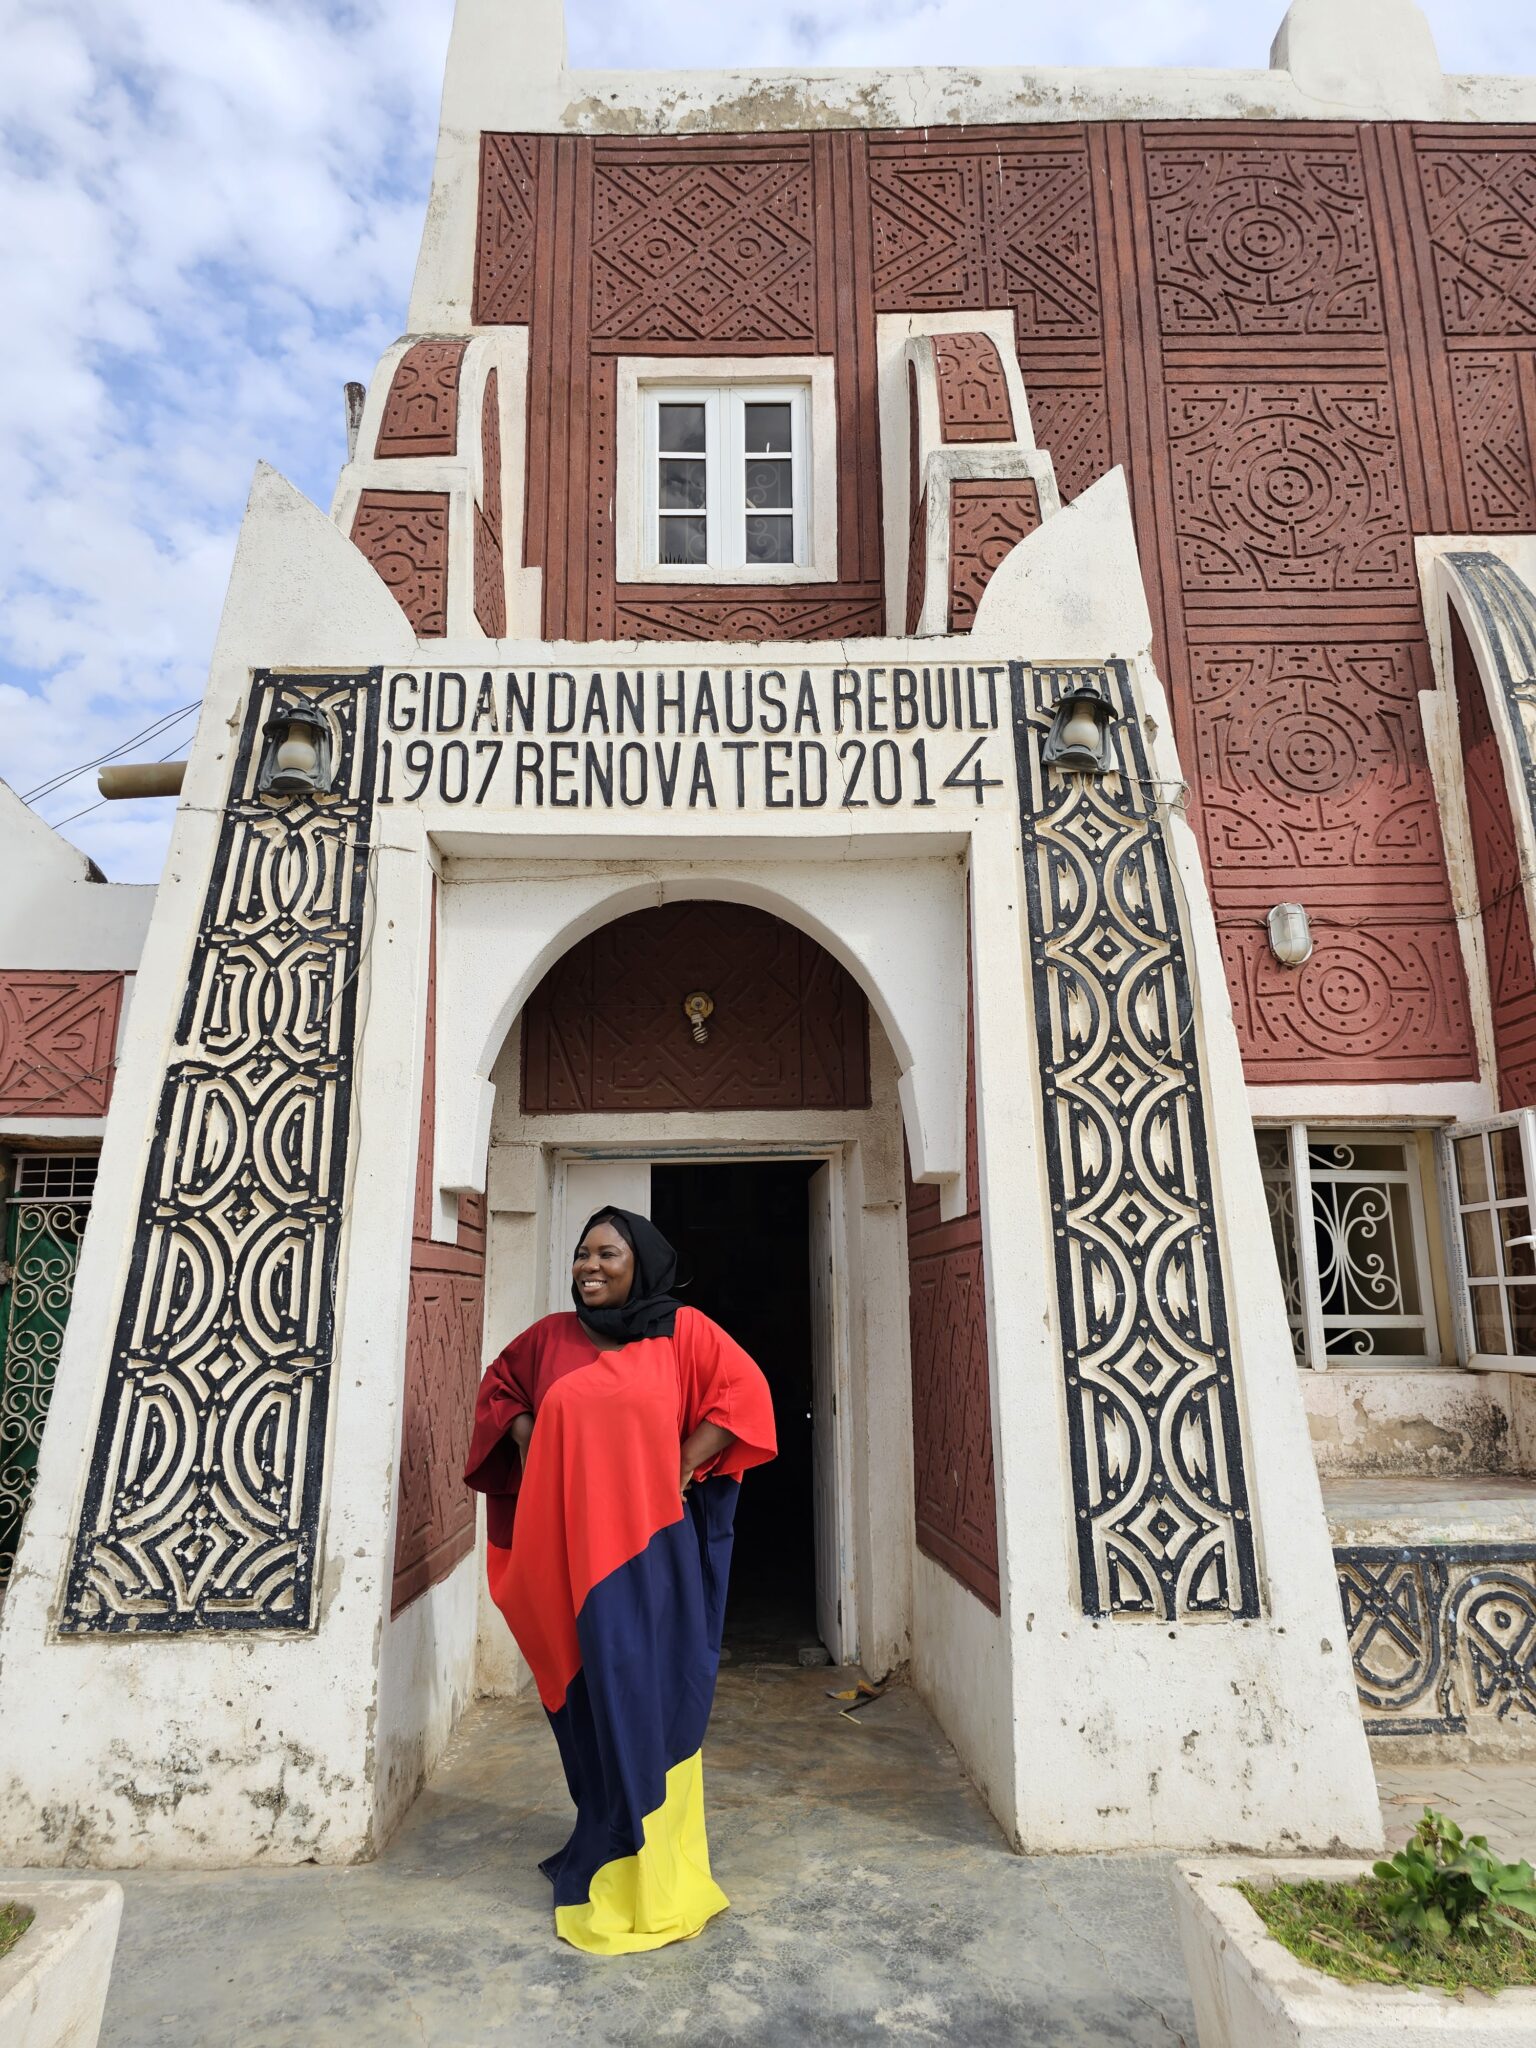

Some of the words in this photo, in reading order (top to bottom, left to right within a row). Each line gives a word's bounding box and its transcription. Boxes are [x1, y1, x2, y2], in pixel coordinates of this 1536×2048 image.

[387, 671, 536, 734] GIDAN
[547, 671, 646, 734] DAN
[656, 670, 822, 734] HAUSA
[832, 666, 1006, 733] REBUILT
[377, 739, 504, 805] 1907
[515, 740, 828, 808] RENOVATED
[839, 736, 1005, 810] 2014
